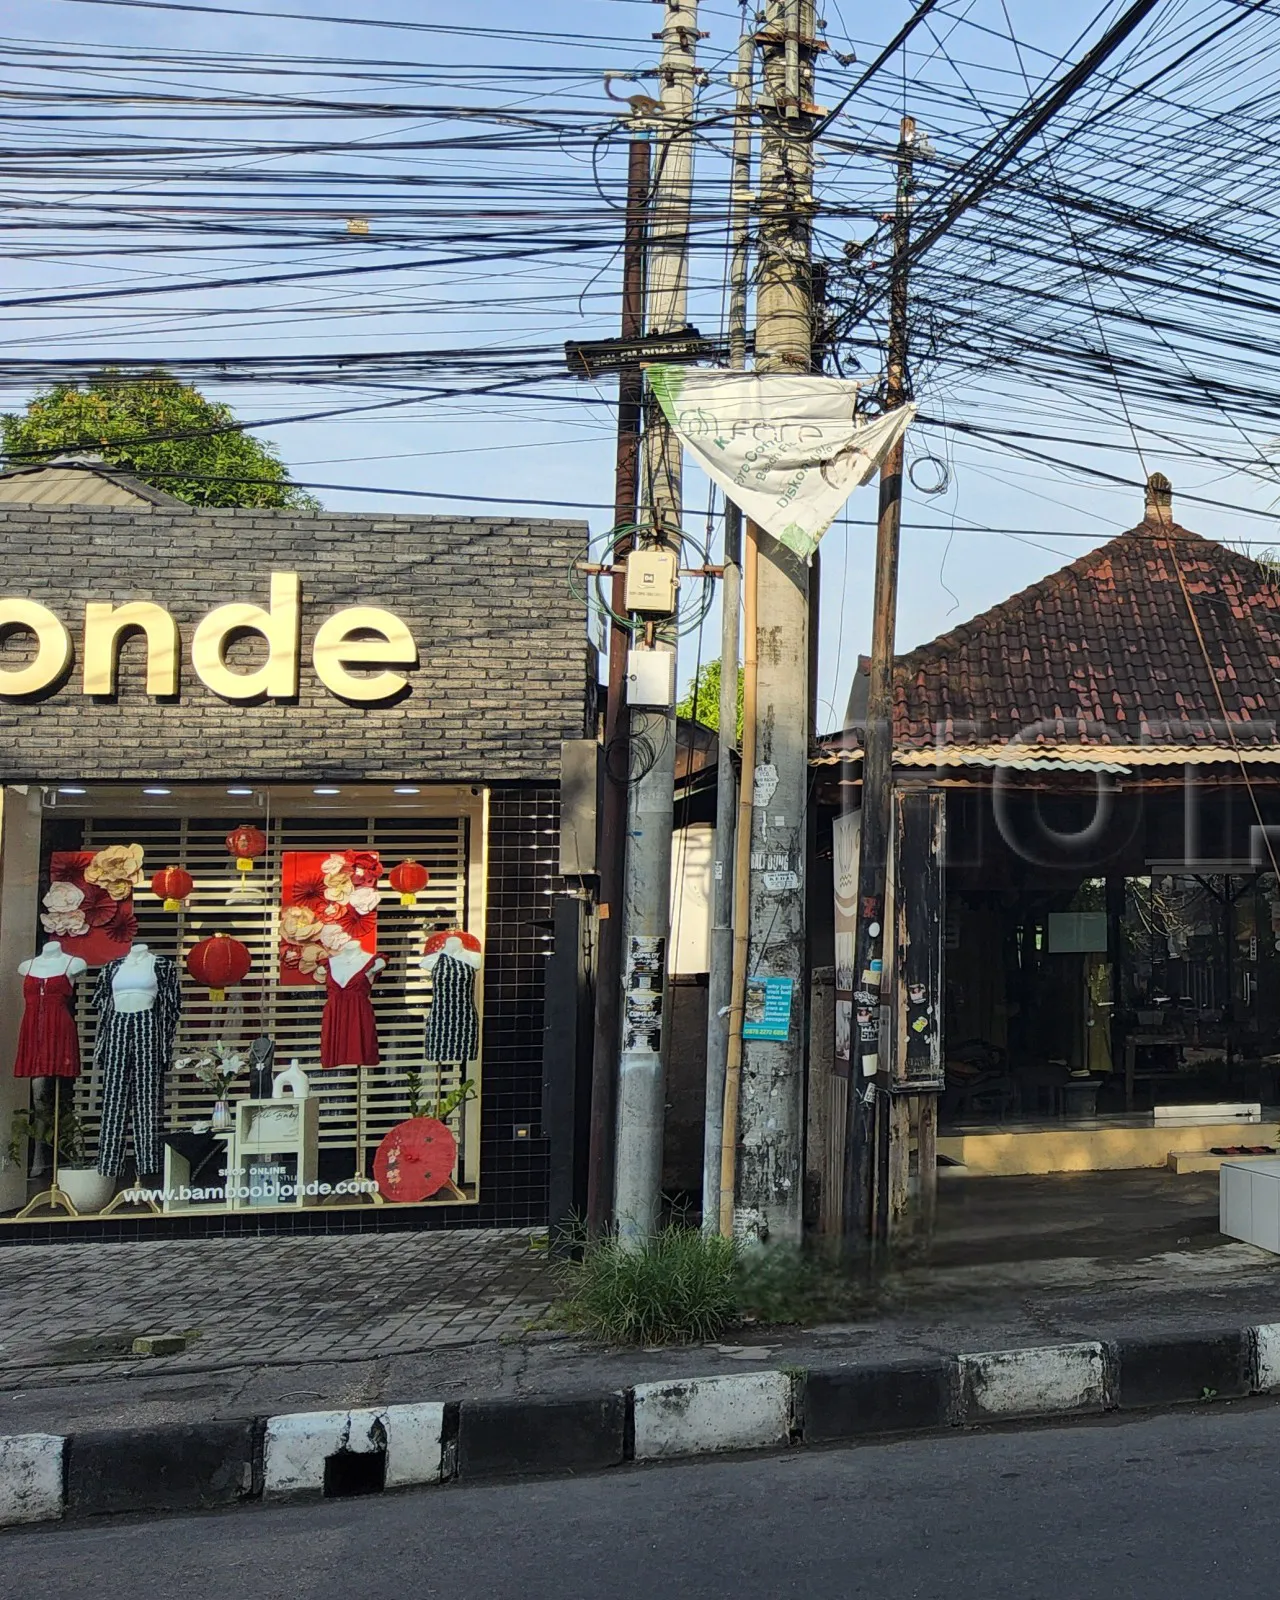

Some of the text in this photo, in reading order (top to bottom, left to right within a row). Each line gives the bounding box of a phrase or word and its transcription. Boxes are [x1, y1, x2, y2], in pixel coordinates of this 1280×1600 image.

[218, 1166, 287, 1177] SHOP ONLINE
[123, 1180, 380, 1203] www.bambooblonde.com
